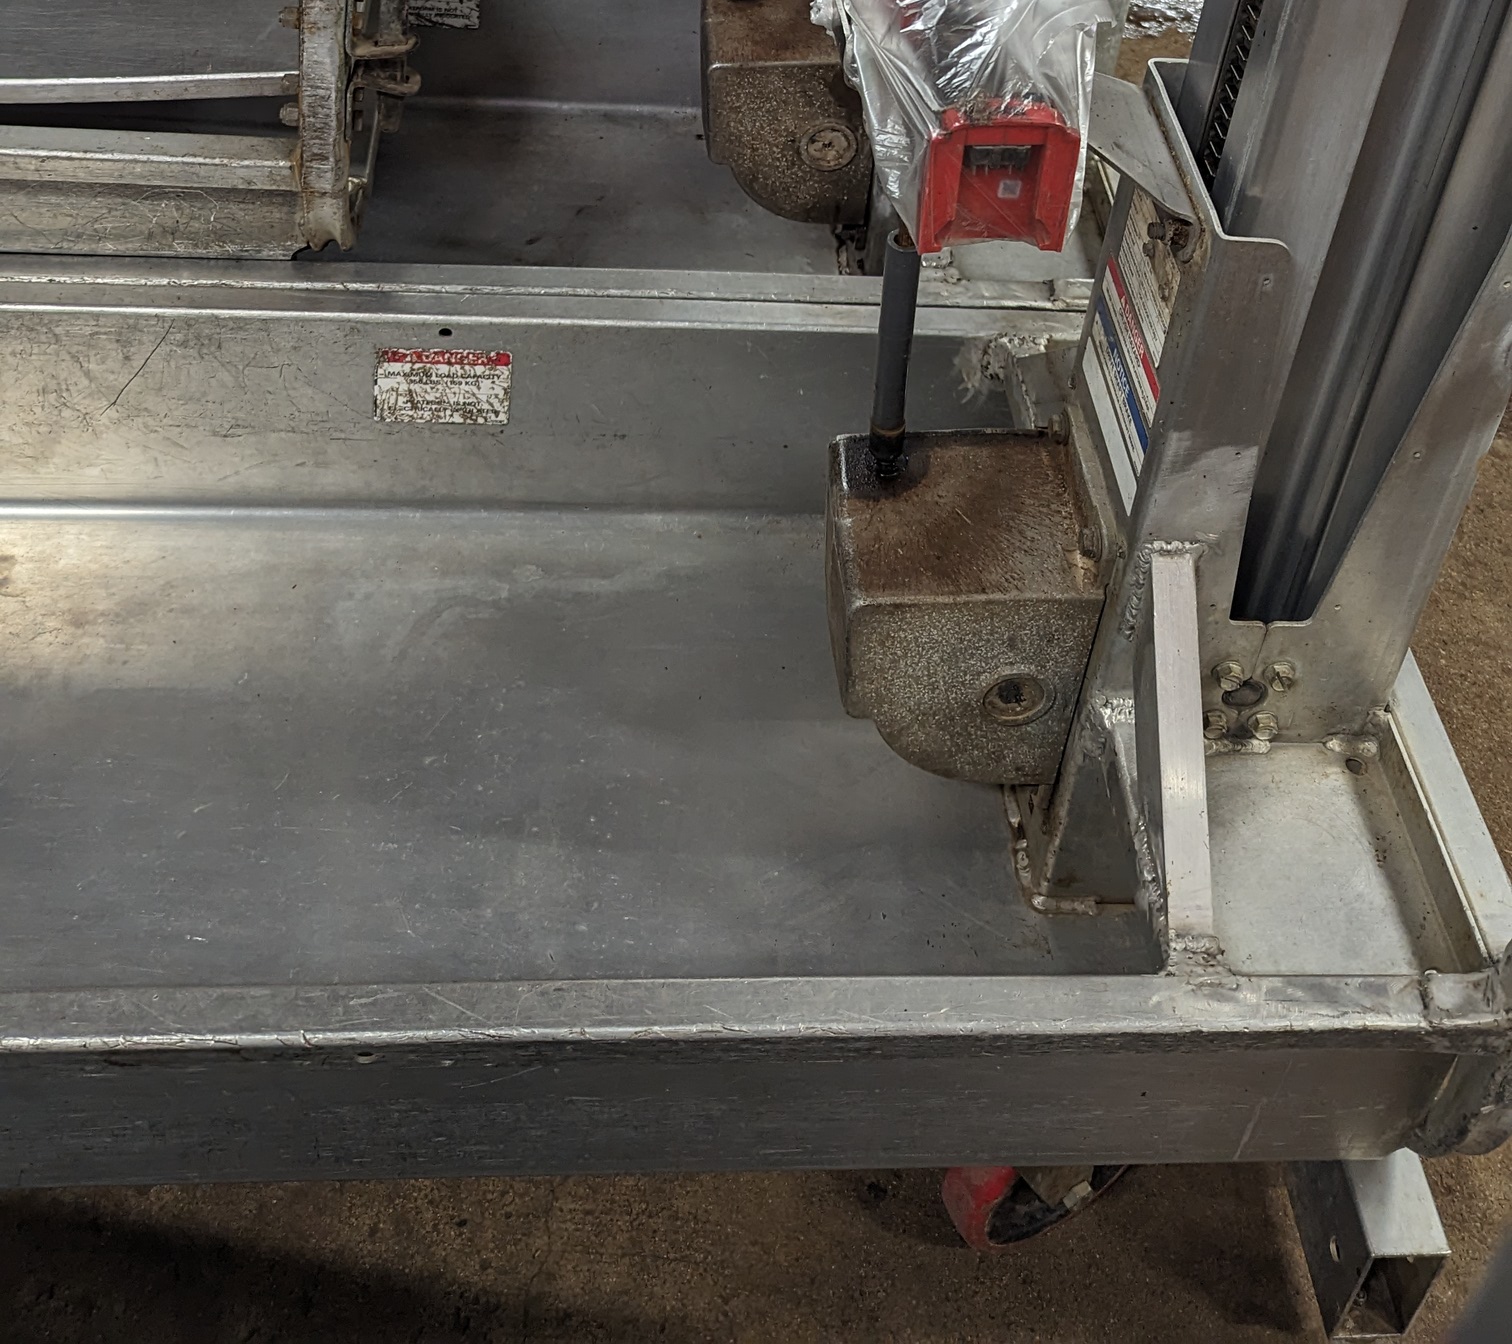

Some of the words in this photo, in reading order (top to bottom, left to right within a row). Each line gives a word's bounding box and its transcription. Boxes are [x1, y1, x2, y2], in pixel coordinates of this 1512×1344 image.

[1124, 303, 1144, 359] DANGER
[422, 352, 488, 364] DANGER
[1112, 347, 1131, 398] NOTICE
